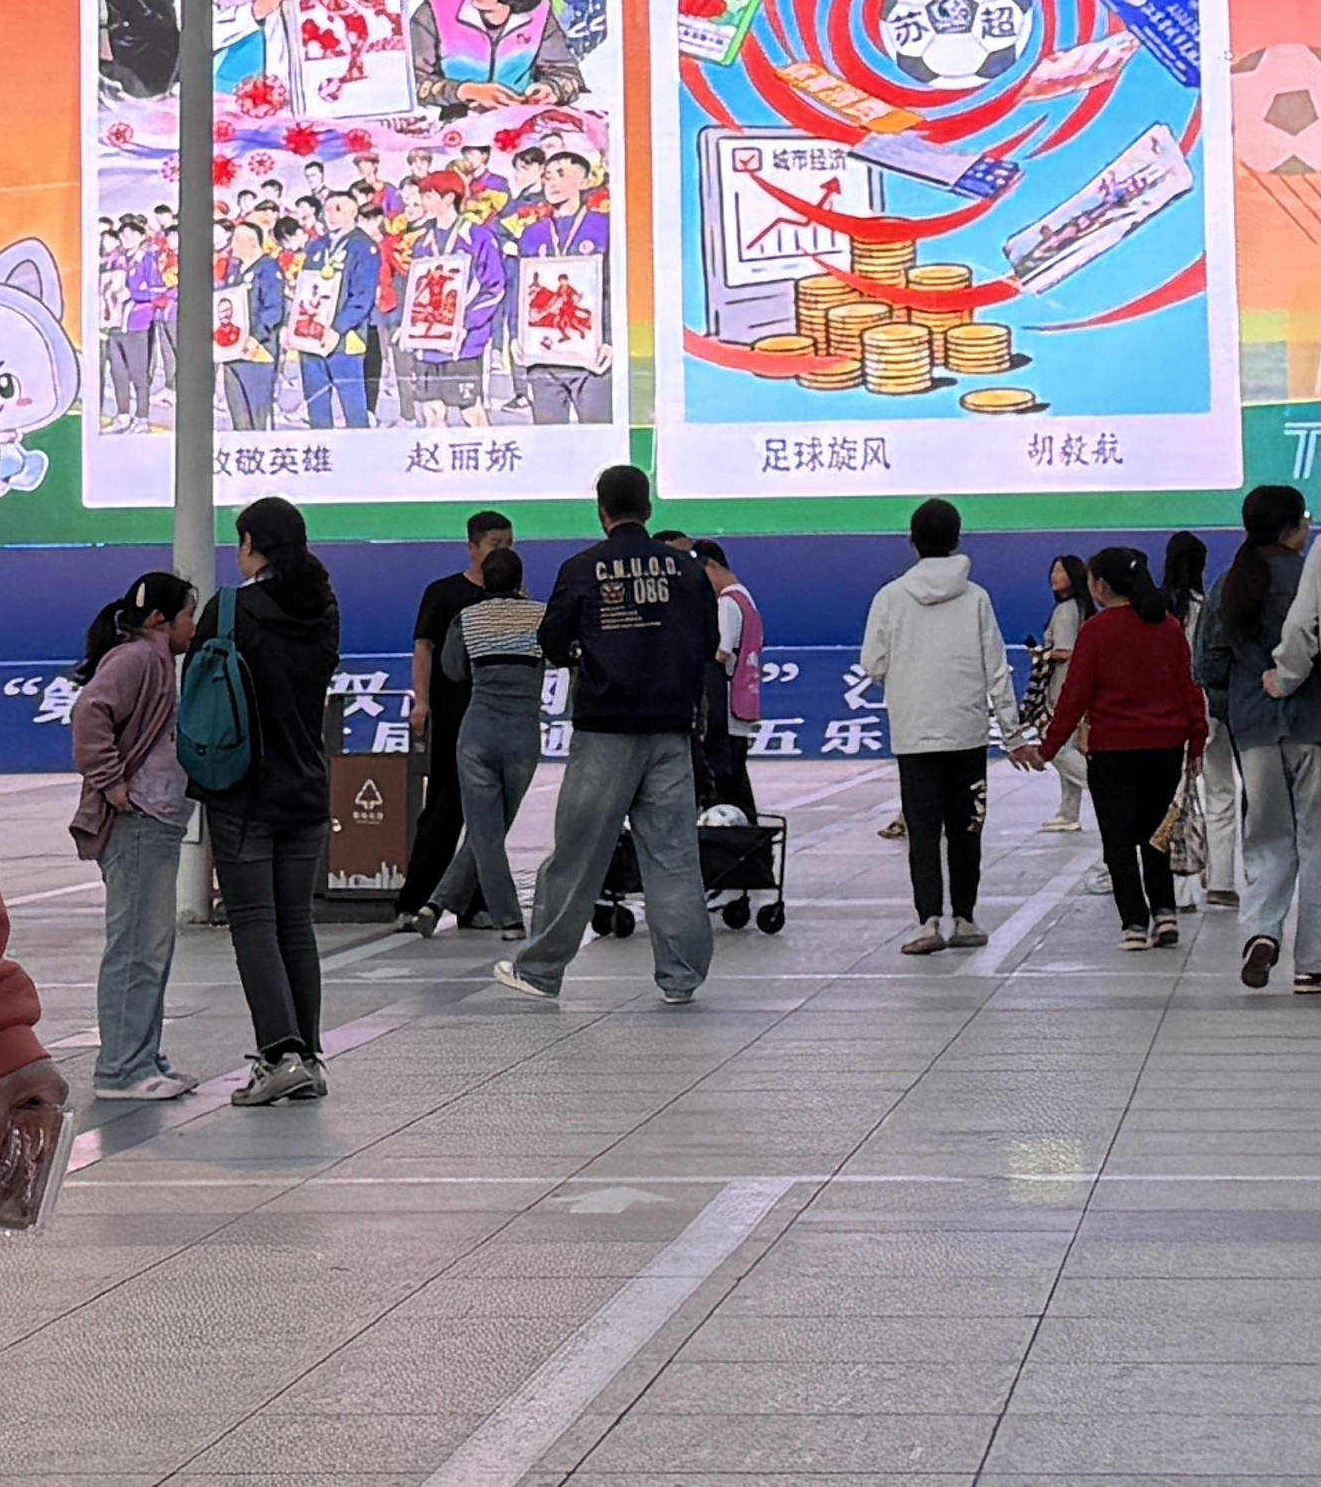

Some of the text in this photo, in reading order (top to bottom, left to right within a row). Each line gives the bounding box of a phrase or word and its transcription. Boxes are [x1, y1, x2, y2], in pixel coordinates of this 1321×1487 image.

[888, 6, 1017, 47] 苏 超
[772, 148, 846, 172] 城市经济
[405, 439, 524, 474] 赵丽娇
[761, 435, 892, 474] 足球旋风
[633, 577, 670, 605] 086
